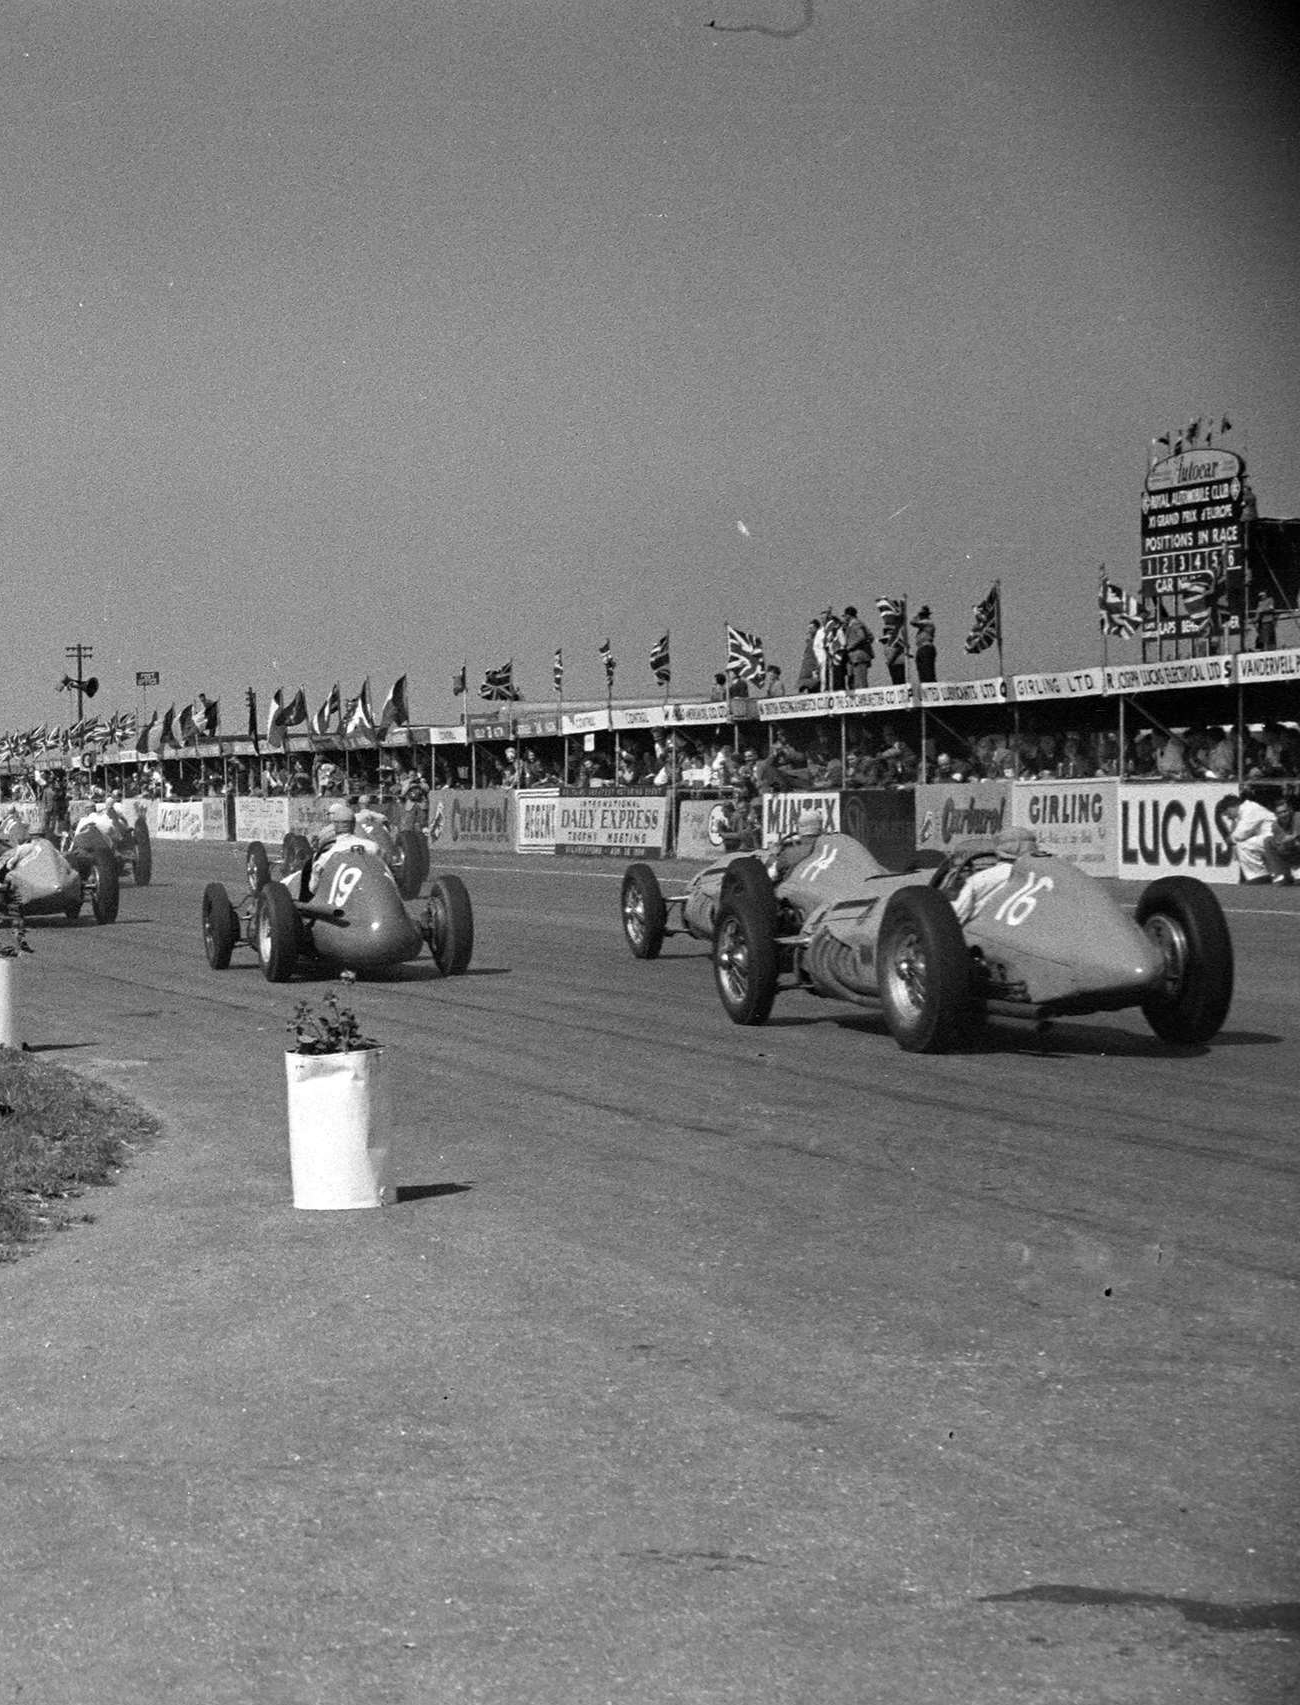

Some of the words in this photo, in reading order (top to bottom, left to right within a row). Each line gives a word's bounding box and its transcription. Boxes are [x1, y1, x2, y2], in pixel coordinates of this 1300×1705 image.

[1150, 493, 1170, 510] ROYAL
[1172, 486, 1209, 505] AUTOMOBILE
[1211, 483, 1229, 500] CLUB
[1157, 512, 1180, 527] GRAND
[1182, 509, 1198, 524] PRIX
[1145, 532, 1194, 552] POSITIONS
[1197, 529, 1209, 545] IN
[1212, 525, 1238, 543] RACE
[1162, 557, 1169, 573] 2
[1179, 555, 1186, 571] 3
[1194, 553, 1201, 570] 4
[1211, 551, 1219, 568] 5
[1228, 549, 1235, 566] 6
[1156, 578, 1174, 593] CAR
[1139, 668, 1165, 686] LUCAS
[1207, 662, 1221, 680] LTD
[1224, 660, 1232, 679] S
[1241, 655, 1295, 677] VANDERVELL
[980, 683, 997, 699] LTD
[1016, 678, 1061, 696] GIRLING
[1067, 674, 1094, 693] LTD
[579, 799, 641, 809] INTERNATIONAL
[1029, 794, 1103, 824] GIRLING
[561, 809, 595, 829] DAILY
[600, 809, 660, 831] EXPRESS
[567, 831, 598, 843] TROPHY
[607, 832, 647, 845] MEETING
[1122, 796, 1235, 868] LUCAS
[328, 863, 362, 907] 19
[995, 872, 1054, 926] 16
